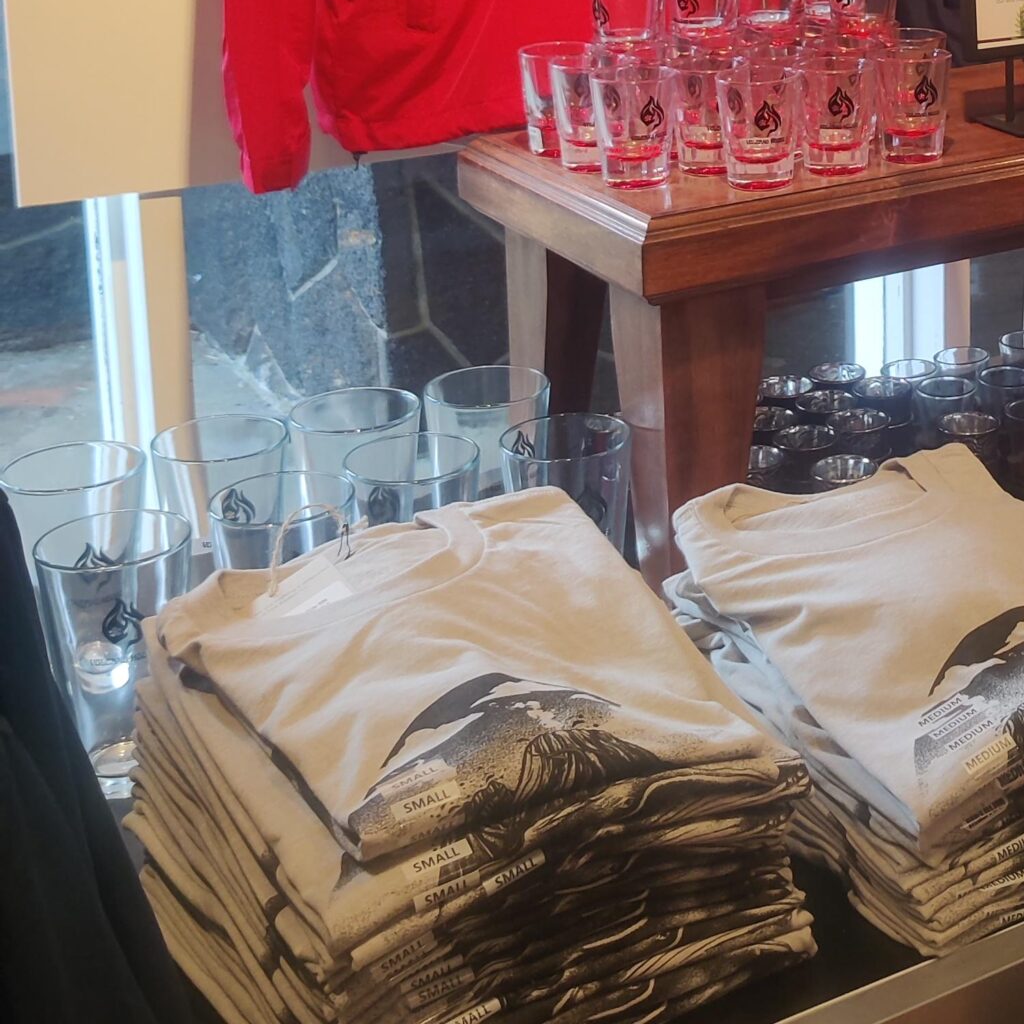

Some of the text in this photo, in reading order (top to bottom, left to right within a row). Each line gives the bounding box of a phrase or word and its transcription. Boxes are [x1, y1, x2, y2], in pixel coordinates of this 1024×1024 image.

[918, 696, 963, 727] MEDIUM
[933, 708, 977, 738] MEDIUM
[948, 719, 994, 751] MEDIUM
[965, 736, 1012, 770] MEDIUM
[392, 767, 439, 789] SMALL
[403, 789, 450, 814] SMALL
[413, 847, 461, 873] SMALL
[495, 857, 538, 887] SMALL
[424, 879, 468, 906] SMALL
[381, 939, 424, 974] SMALL
[410, 964, 452, 989] SMALL
[418, 977, 463, 1002] SMALL
